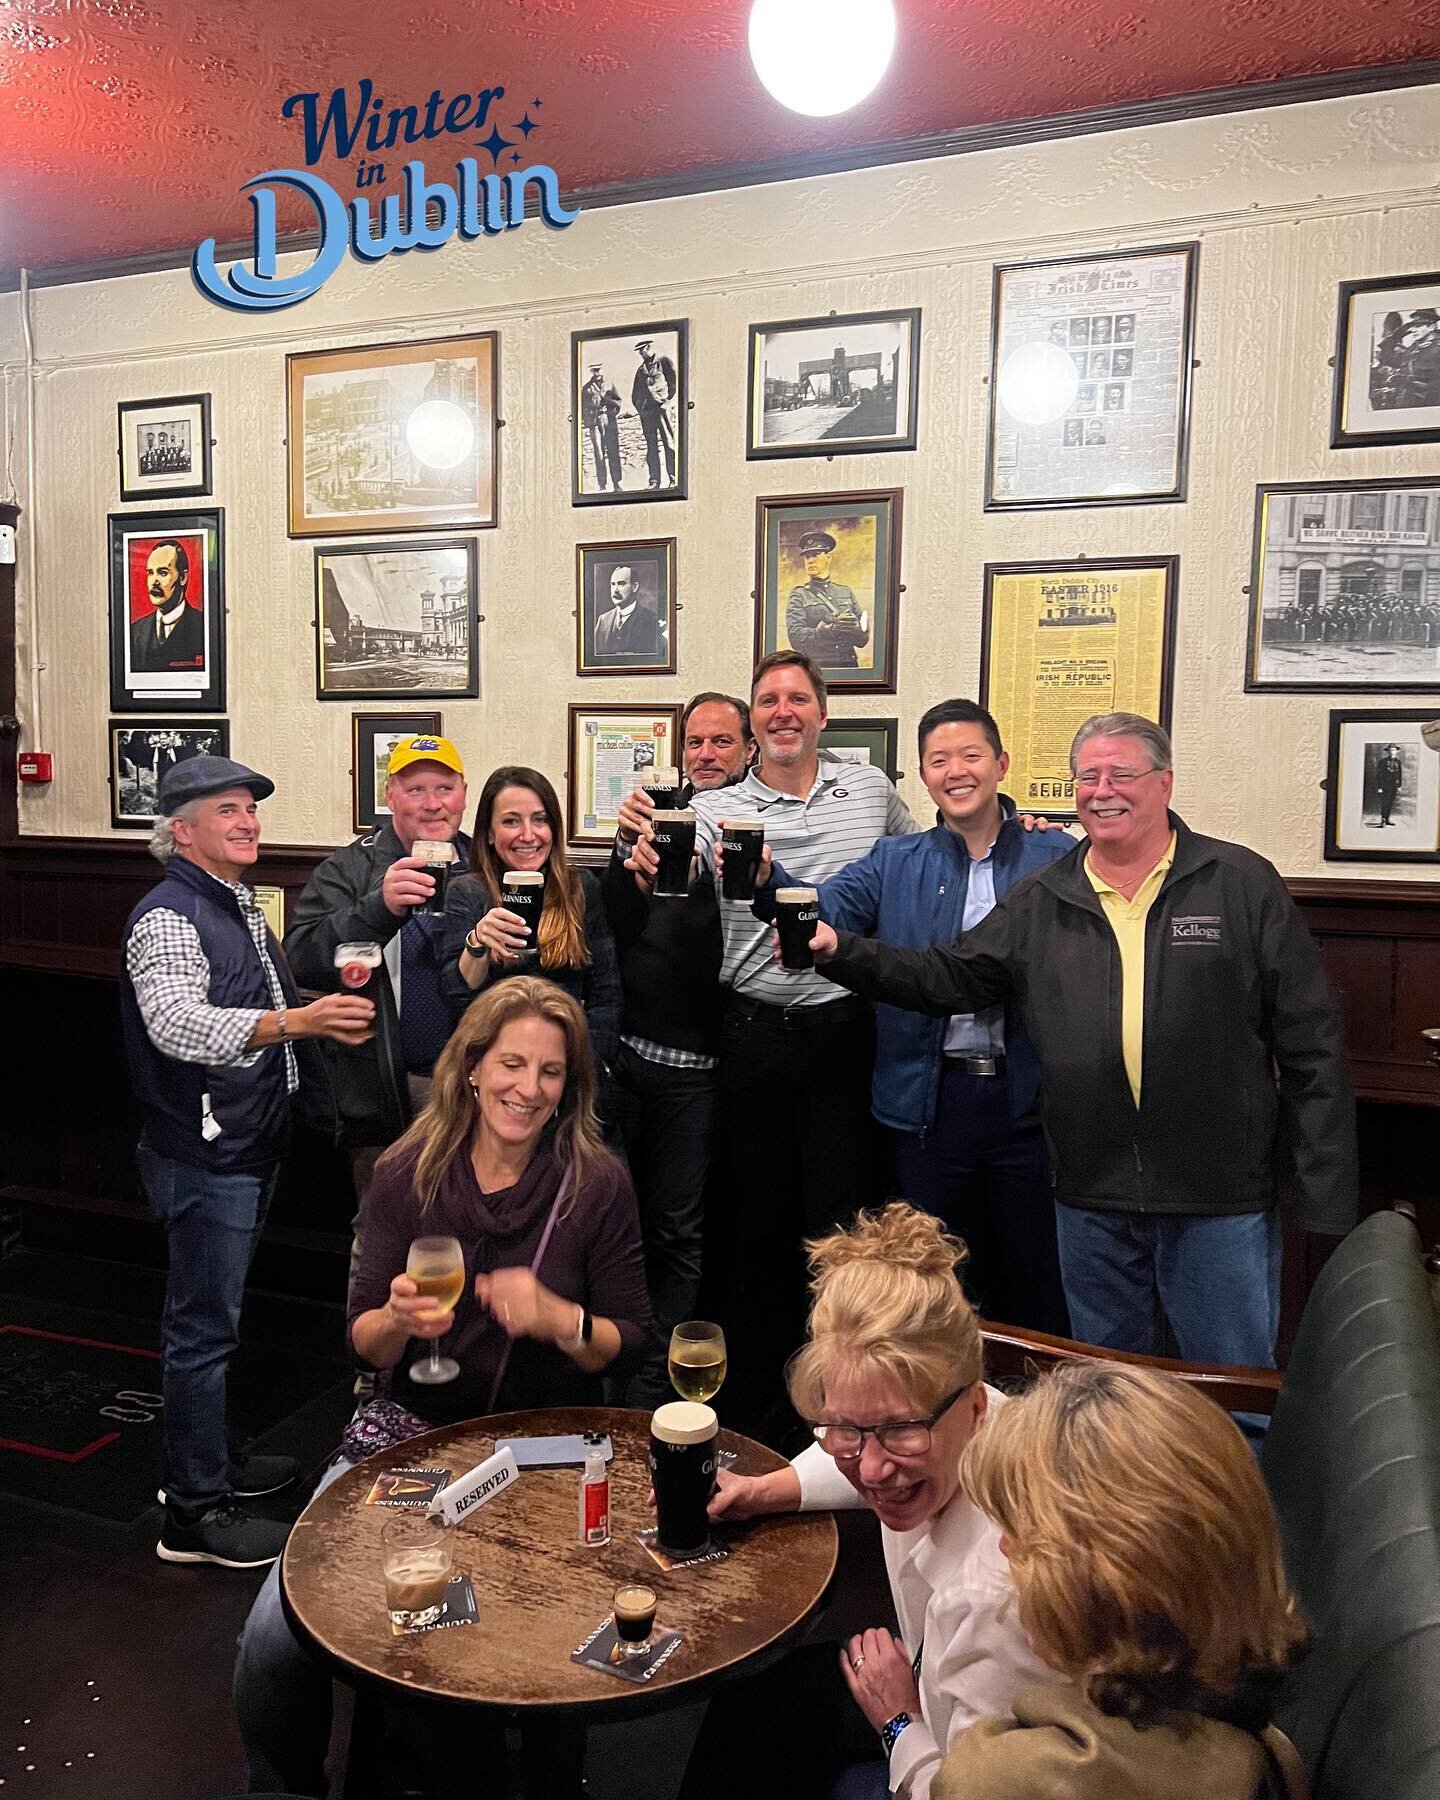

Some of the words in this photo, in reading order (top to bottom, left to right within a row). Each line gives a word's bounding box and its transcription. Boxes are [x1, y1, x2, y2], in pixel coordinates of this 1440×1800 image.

[1094, 584, 1119, 593] 1916
[1065, 673, 1112, 681] REPUBLIC
[832, 788, 849, 799] G
[1172, 923, 1221, 940] Kellogg
[454, 1467, 510, 1515] RESERVED
